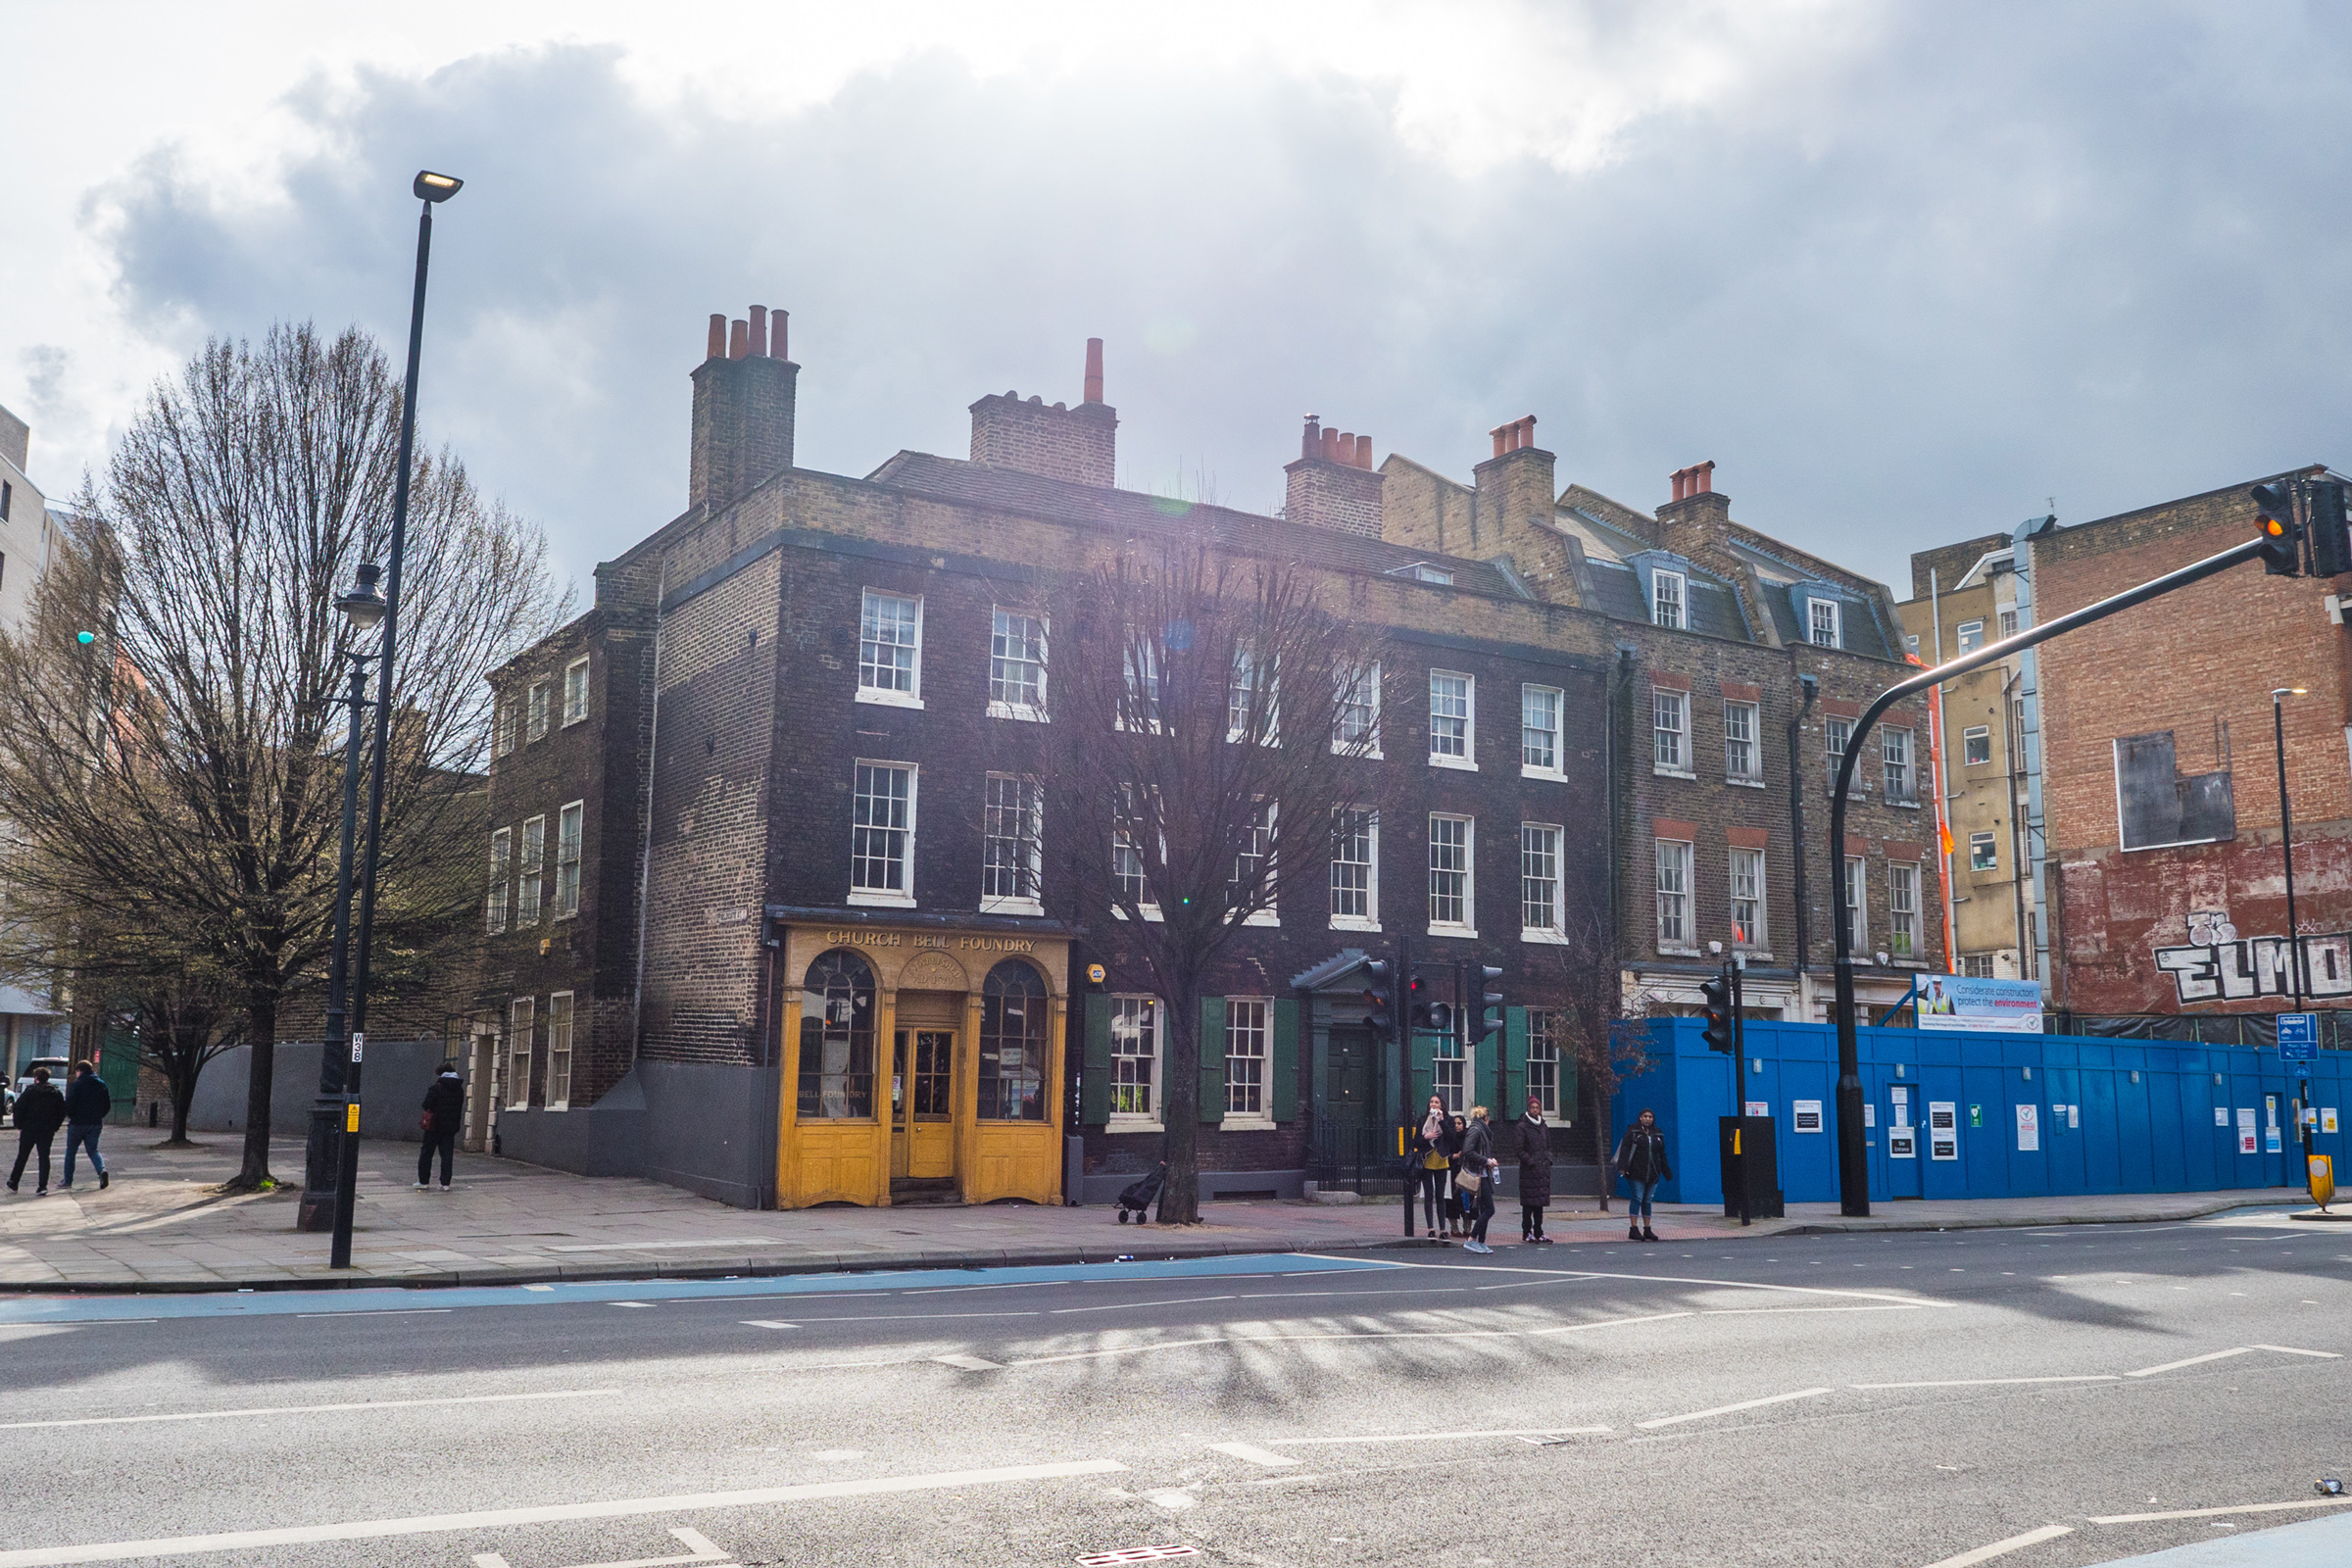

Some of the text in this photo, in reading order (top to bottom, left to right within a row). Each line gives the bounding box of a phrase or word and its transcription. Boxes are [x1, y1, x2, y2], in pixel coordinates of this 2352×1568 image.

[827, 931, 1037, 953] CHURCH BELL FOUNDRY
[907, 956, 960, 979] ESTABLISHED
[1956, 984, 2034, 998] Considerate constructors
[1958, 997, 2037, 1008] protect the environment
